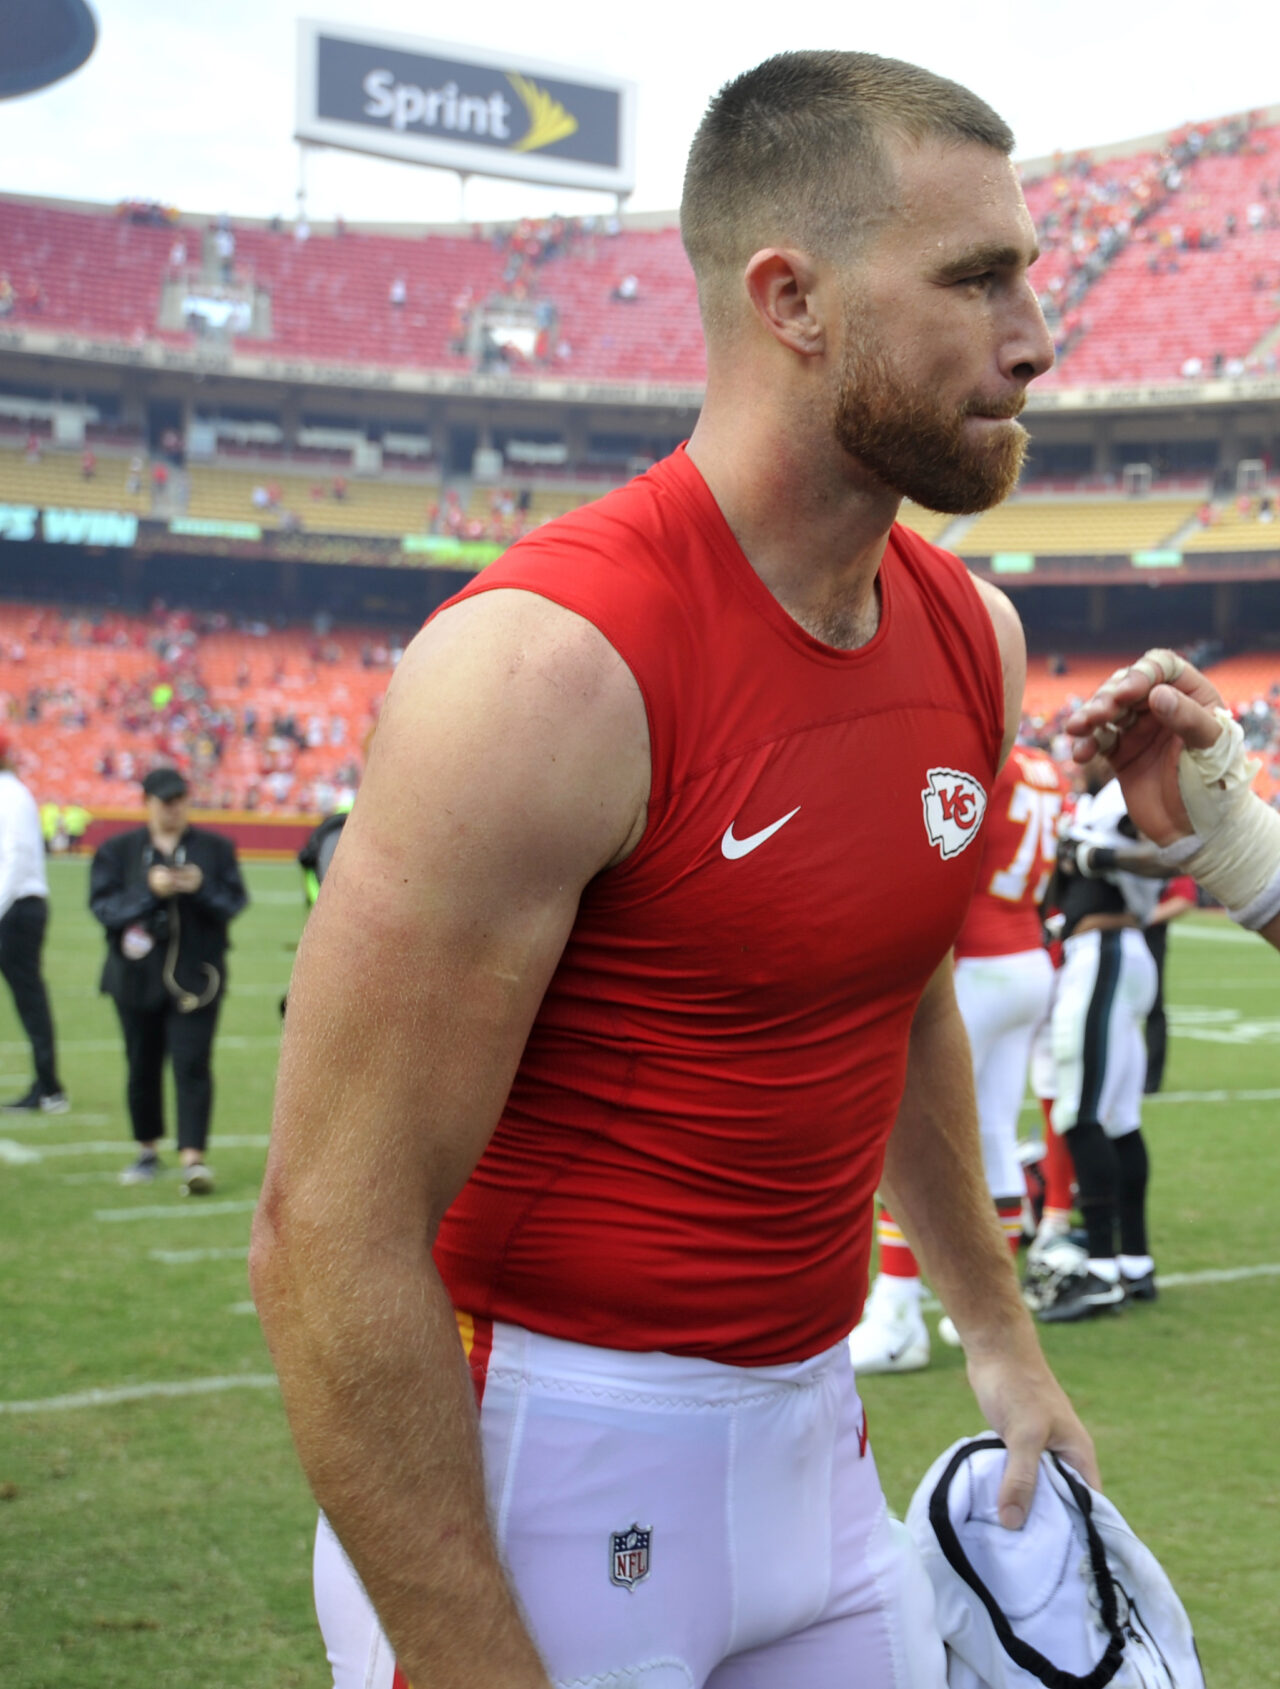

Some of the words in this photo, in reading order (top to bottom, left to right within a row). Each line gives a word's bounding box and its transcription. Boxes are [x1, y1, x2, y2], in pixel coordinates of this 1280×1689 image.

[363, 68, 512, 141] Sprint
[42, 505, 139, 549] WIN
[938, 784, 977, 830] KC
[617, 1551, 645, 1578] NFL
